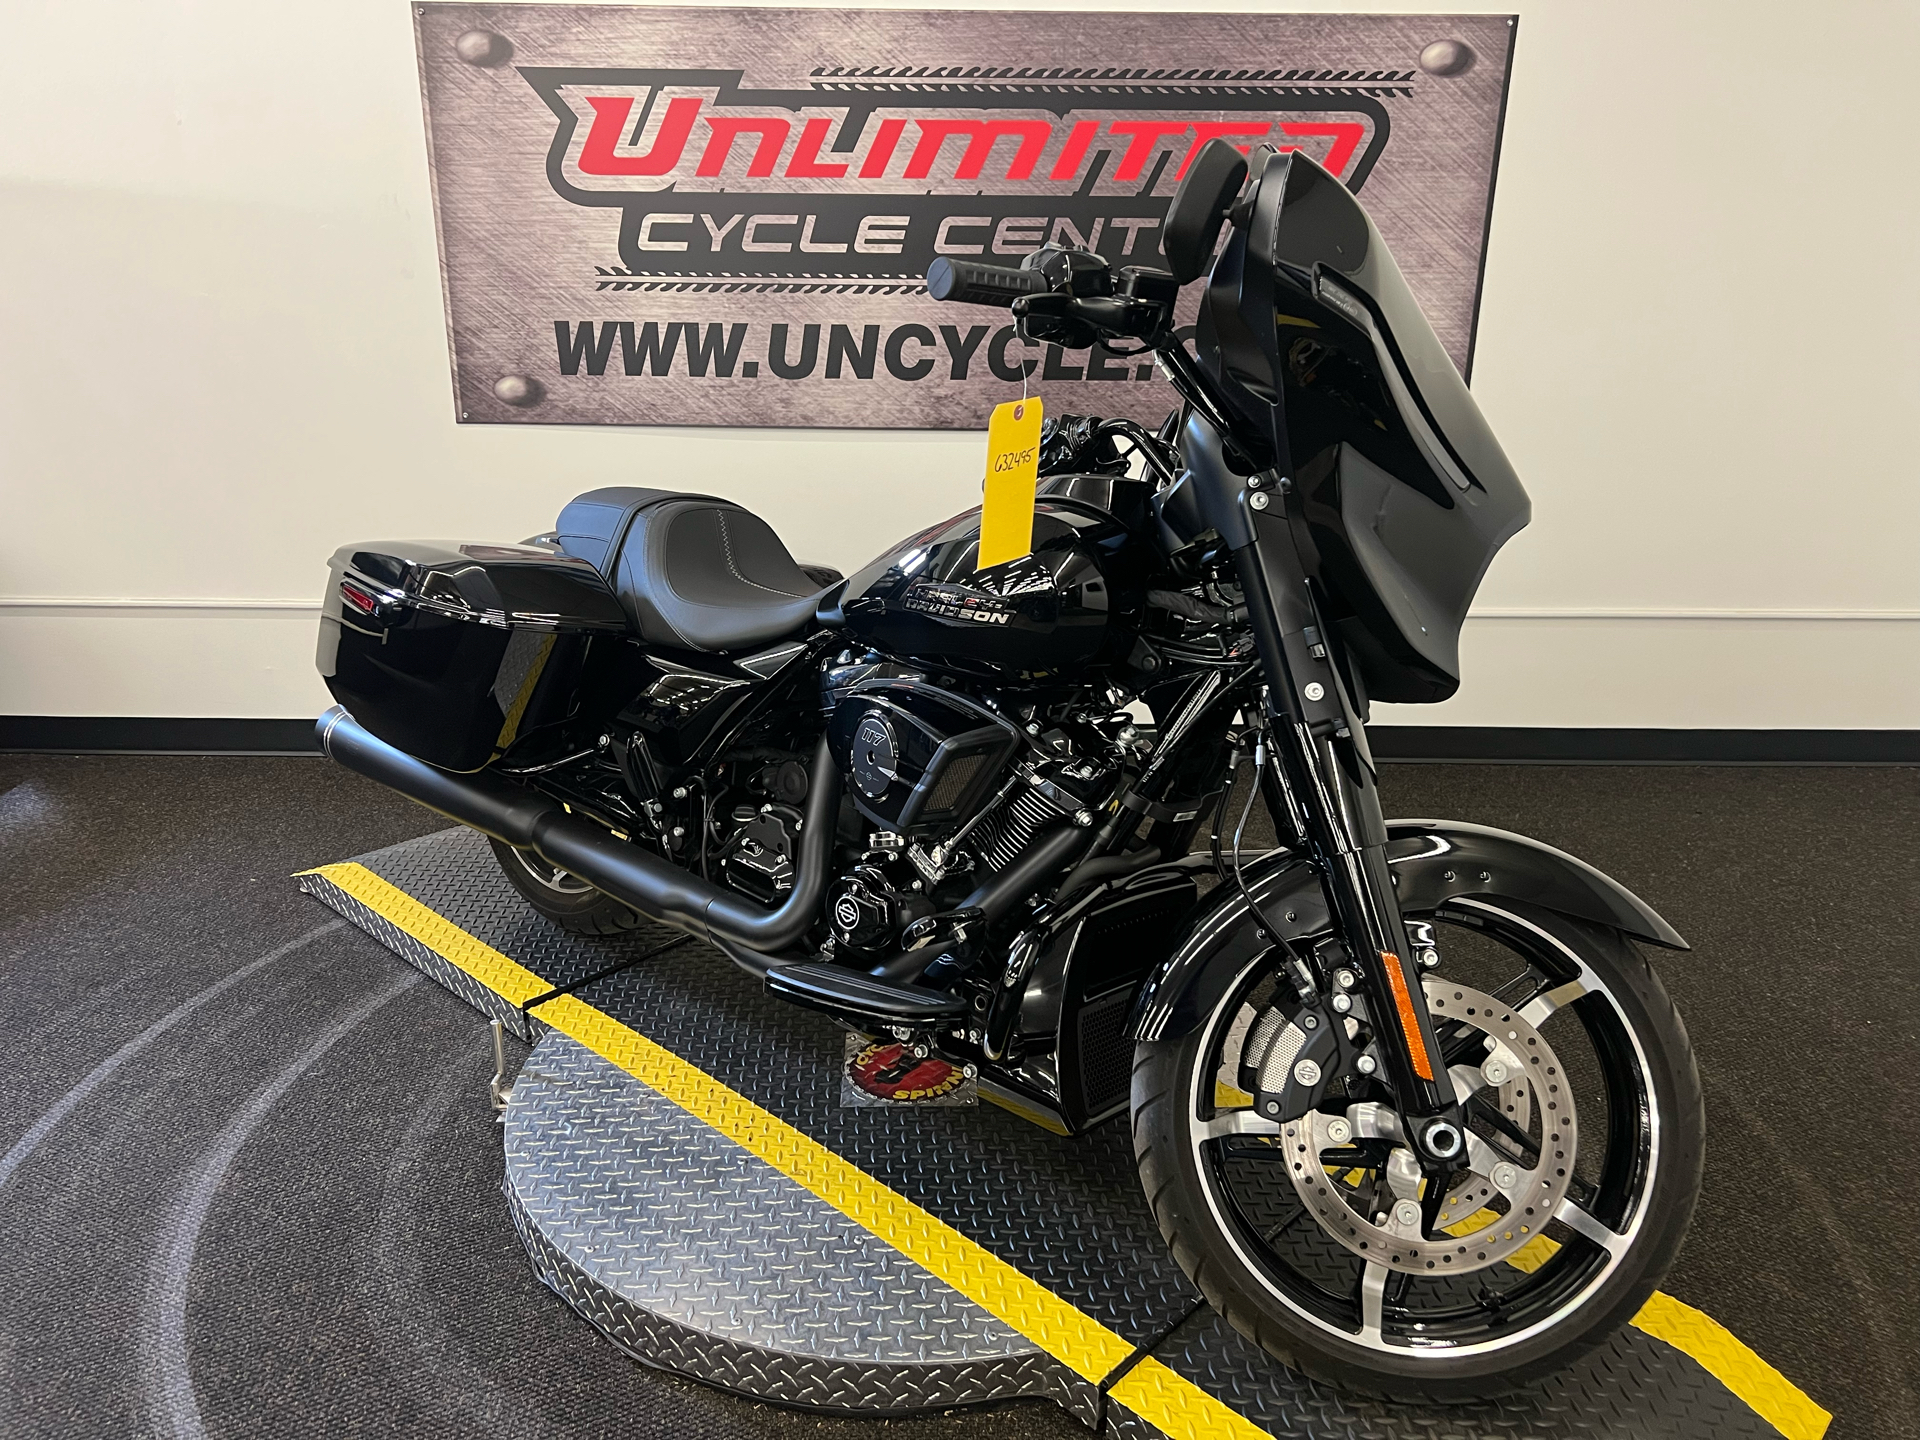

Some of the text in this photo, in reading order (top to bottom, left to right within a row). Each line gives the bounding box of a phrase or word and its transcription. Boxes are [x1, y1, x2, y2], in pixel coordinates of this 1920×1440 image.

[637, 213, 1168, 256] CYCLE CENT
[554, 320, 1200, 382] WWW.UNCYCLE.
[994, 446, 1036, 473] 632495
[861, 727, 886, 746] 117
[856, 1043, 886, 1066] CYC
